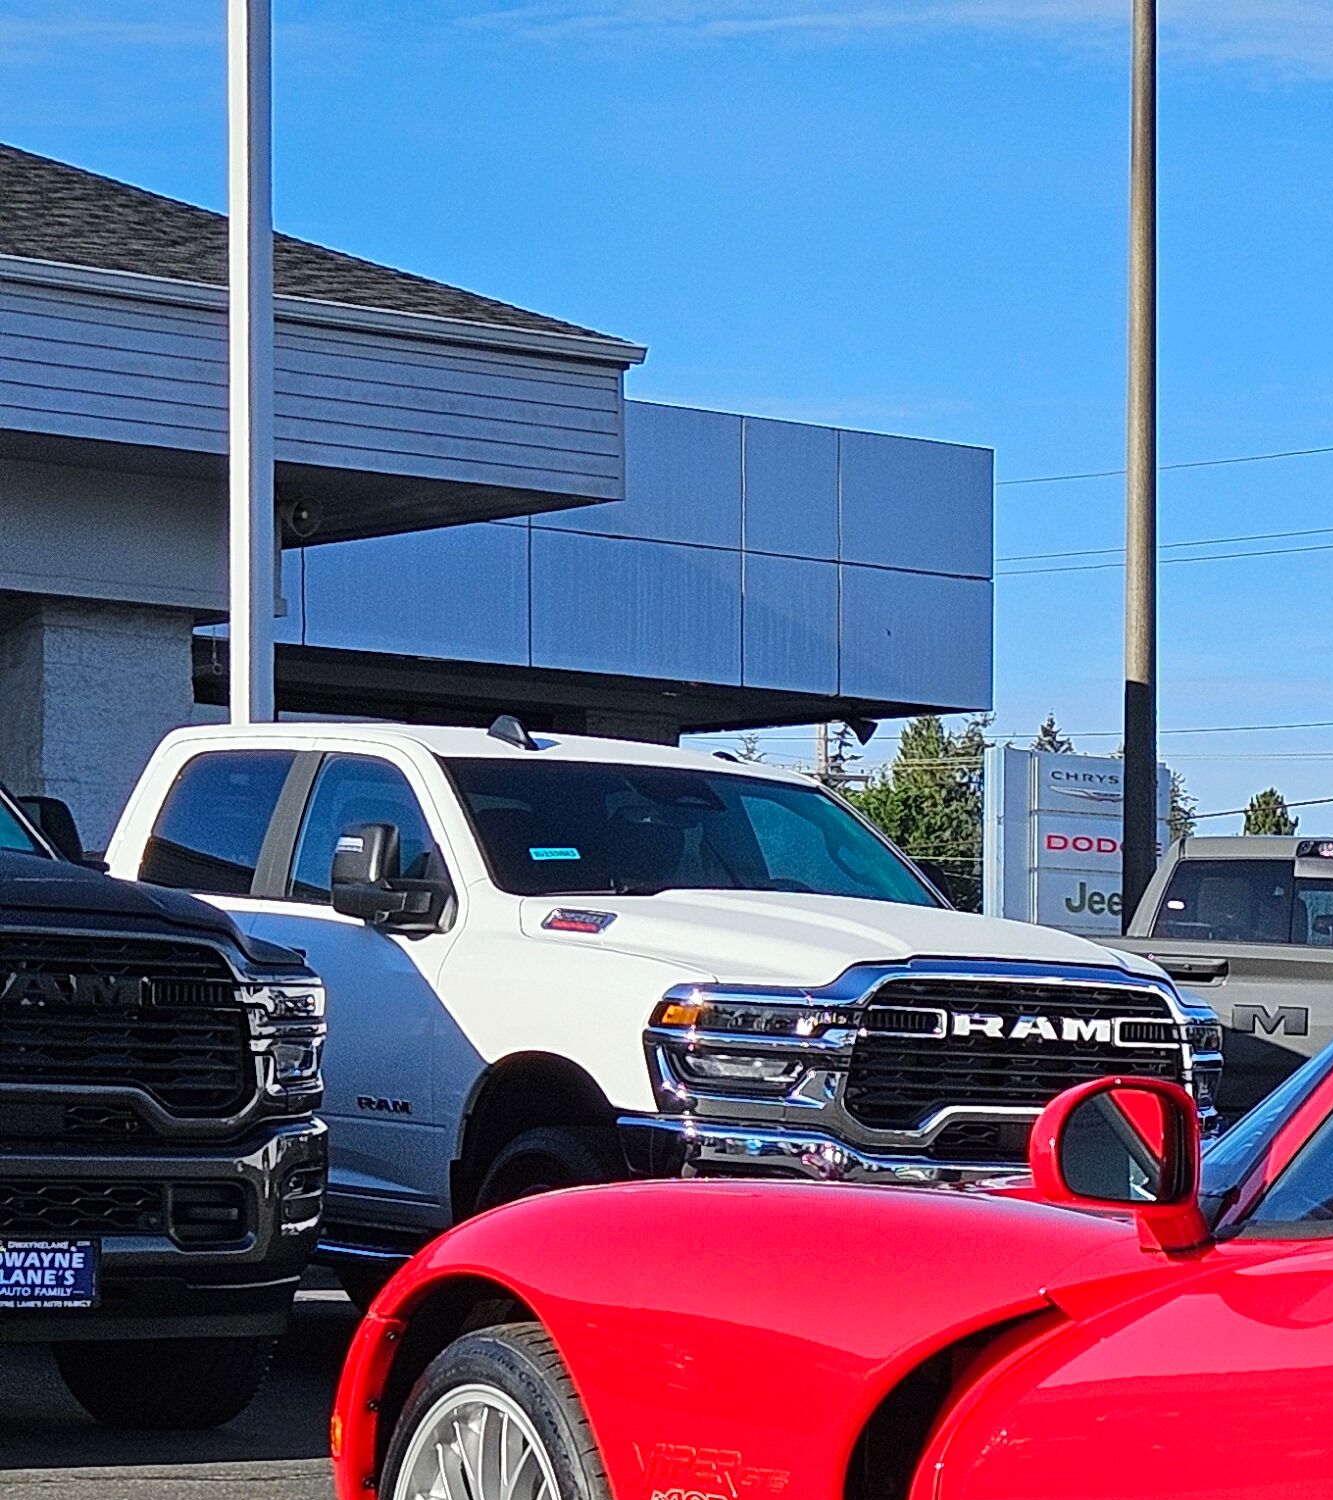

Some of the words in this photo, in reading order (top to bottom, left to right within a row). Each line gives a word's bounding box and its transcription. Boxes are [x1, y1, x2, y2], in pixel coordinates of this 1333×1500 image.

[1051, 770, 1120, 785] CHRYS
[1065, 882, 1123, 916] Jee
[951, 1012, 1112, 1042] RAM
[356, 1095, 413, 1114] RAM
[0, 1251, 85, 1269] WAYNE
[0, 1268, 76, 1286] LANE'S
[0, 1286, 32, 1297] AUTO
[34, 1286, 74, 1297] FAMILY
